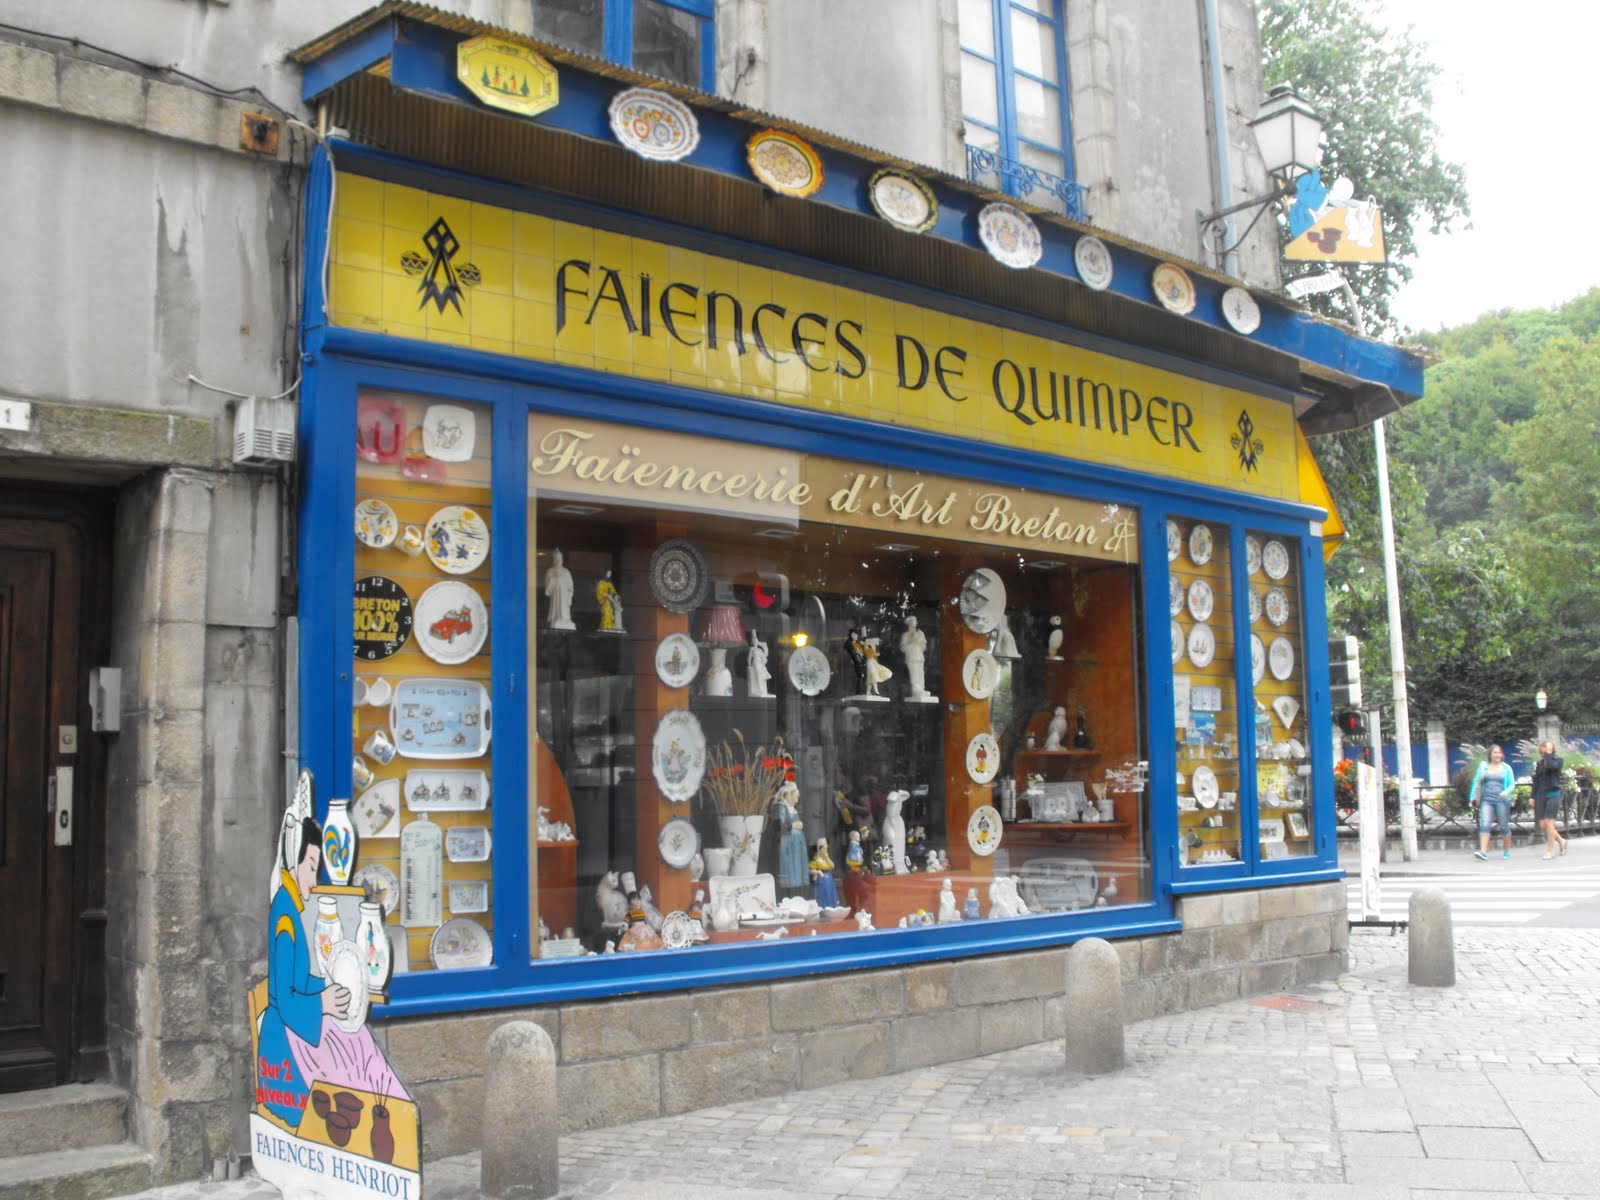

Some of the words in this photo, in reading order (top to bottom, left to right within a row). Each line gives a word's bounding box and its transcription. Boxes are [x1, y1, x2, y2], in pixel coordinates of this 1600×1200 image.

[556, 260, 867, 379] FAÏENCES
[894, 334, 969, 402] DE
[992, 358, 1203, 453] QUIMPER
[531, 428, 813, 506] Faïencerie
[829, 473, 958, 524] d'Art
[969, 493, 1099, 545] Breton
[372, 577, 383, 586] 12
[392, 583, 396, 592] 1
[401, 598, 408, 606] 2
[404, 616, 411, 624] 3
[398, 634, 406, 642] 4
[368, 651, 376, 659] 6
[259, 1057, 280, 1079] Sur
[283, 1060, 293, 1081] 2
[256, 1081, 308, 1111] niveaux
[256, 1132, 325, 1174] FAIENCES
[332, 1156, 411, 1200] HENRIOT
